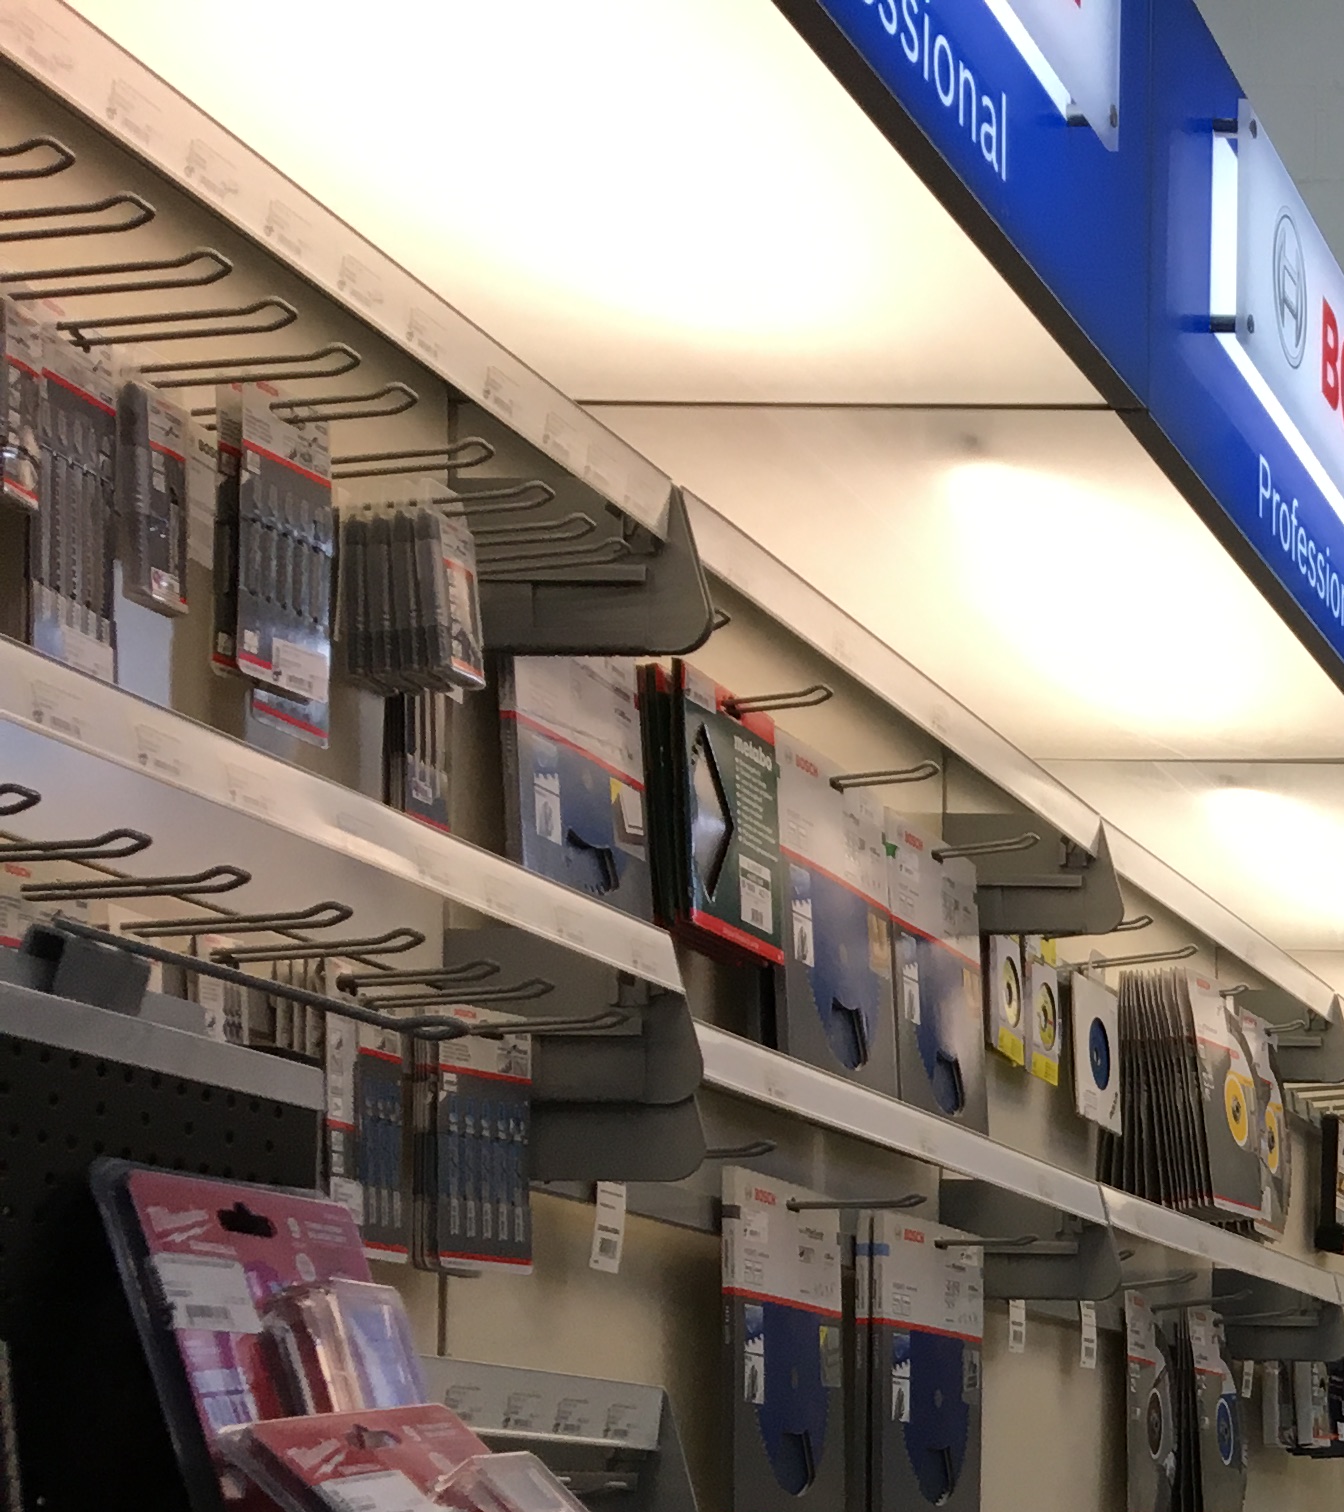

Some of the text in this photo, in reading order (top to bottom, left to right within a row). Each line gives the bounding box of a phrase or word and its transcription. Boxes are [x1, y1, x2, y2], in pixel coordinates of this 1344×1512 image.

[864, 0, 1007, 181] ssional
[733, 735, 772, 771] metabo
[795, 753, 819, 777] BOSCH
[754, 1187, 776, 1205] BOSCH
[903, 1227, 925, 1244] BOSCH
